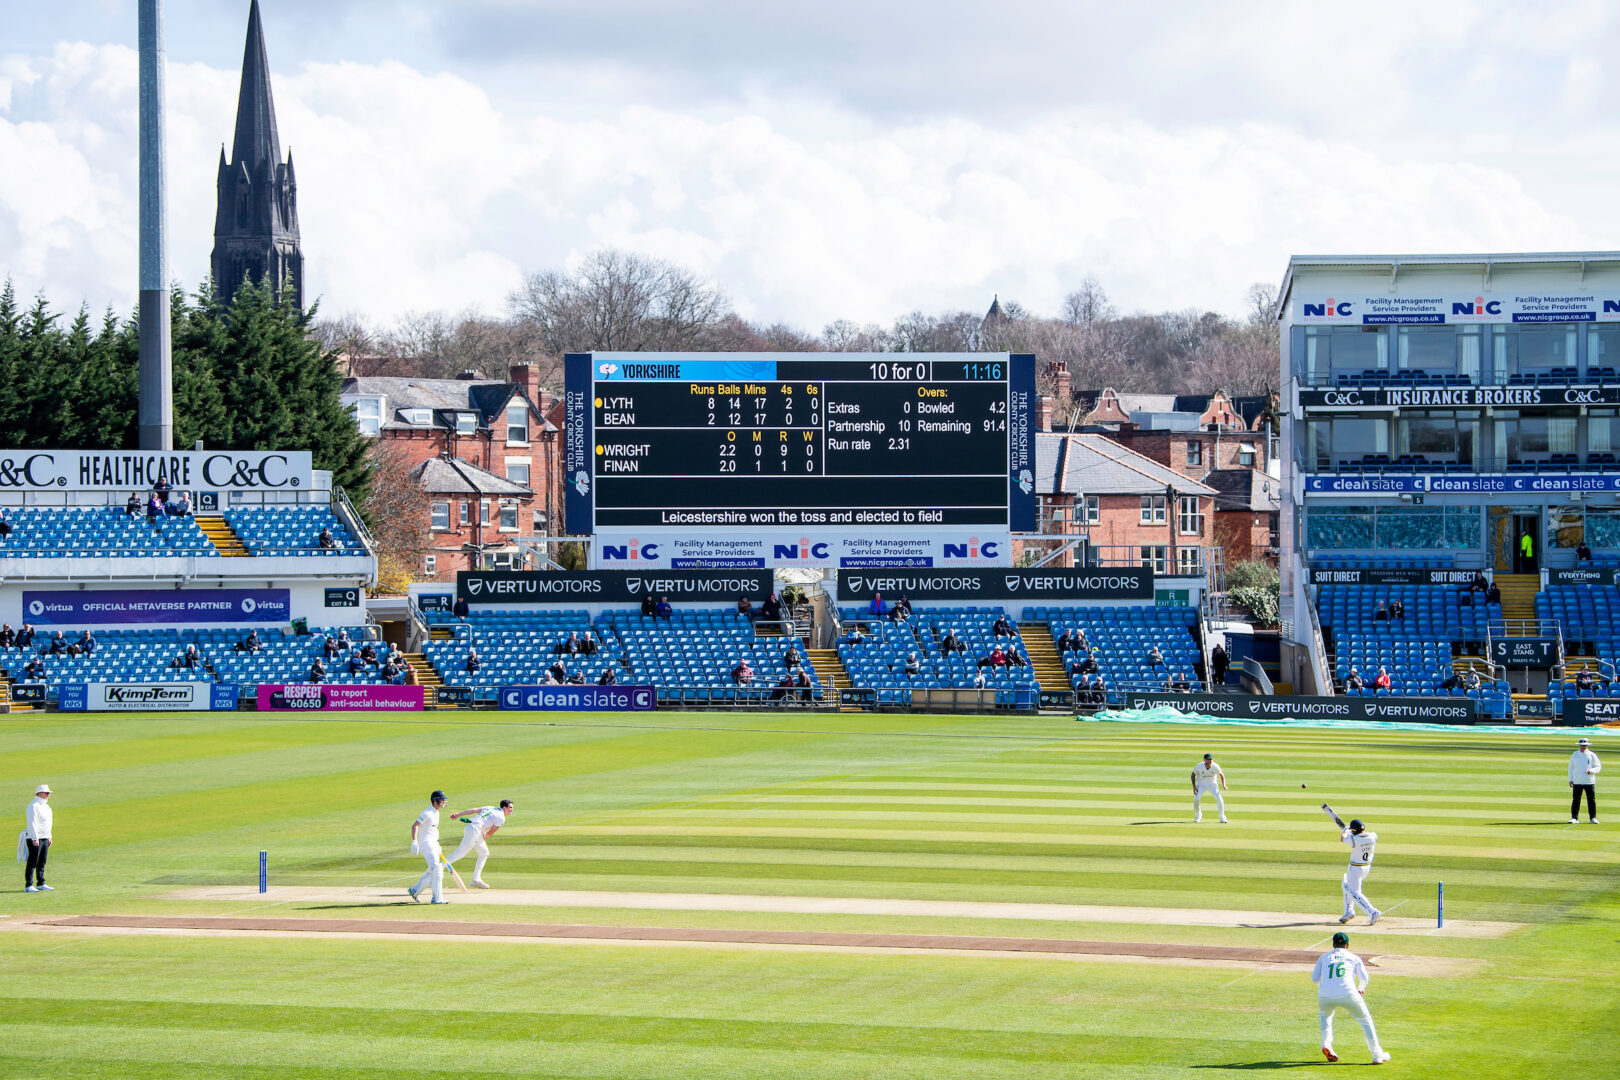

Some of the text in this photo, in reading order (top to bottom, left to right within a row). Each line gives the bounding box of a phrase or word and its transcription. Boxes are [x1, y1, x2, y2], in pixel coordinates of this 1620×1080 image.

[1394, 297, 1443, 305] Management
[1515, 296, 1594, 304] Facility Management
[1368, 315, 1439, 323] www.nicgroup.co.uk
[1517, 313, 1590, 322] www.nicgroup.co.uk
[622, 364, 680, 379] YORKSHIRE
[869, 363, 926, 380] 10 for 0
[962, 363, 1001, 380] 11:16
[690, 384, 818, 395] Runs Balls Mins 4s 6s
[917, 387, 949, 398] Overs:
[604, 397, 818, 409] LYTH 8 14 17 2 0
[1387, 389, 1541, 405] INSURANCE BROKERS
[828, 402, 911, 414] Extras 0
[918, 402, 1006, 414] Bowled 4.2
[604, 413, 818, 425] BEAN 2 12 17 0 0
[575, 391, 584, 467] THE YORKSHIRE
[828, 420, 911, 434] Partnership 10
[918, 420, 1006, 434] Remaining 91.4
[1019, 391, 1028, 466] THE YORKSHIRE
[753, 431, 814, 442] M R W
[604, 444, 813, 456] WRIGHT 2.2 0 9 0
[828, 438, 910, 450] Run rate 2.31
[80, 456, 190, 485] HEALTHCARE
[604, 460, 813, 472] FINAN 2.0 1 1 0
[1333, 479, 1404, 490] clean slate
[1433, 478, 1605, 490] clean slate clean slate
[202, 495, 212, 505] Q
[661, 510, 943, 523] Leicestershire won the toss and elected to field
[674, 540, 763, 549] Facility Management
[843, 539, 930, 548] Facility Management
[677, 559, 758, 568] wwwnicgroup.co.uk
[1315, 571, 1332, 582] SUIT
[1334, 571, 1361, 582] DIRECT
[1430, 571, 1448, 582] SUIT
[1449, 571, 1477, 582] DIRECT
[485, 579, 602, 593] VERTU MOTORS
[644, 579, 759, 592] VERTU MOTORS
[866, 577, 981, 590] VERTU MOTORS
[1023, 576, 1139, 590] VERTU MOTORS
[346, 591, 356, 601] Q
[441, 596, 448, 606] R
[45, 601, 284, 612] virtua OFFICIAL METAVERSE PARTNER virtua
[1497, 642, 1507, 655] S
[1540, 642, 1550, 655] T
[108, 688, 188, 702] KrimpTerm
[284, 686, 322, 698] RESPECT
[330, 689, 367, 698] to report
[290, 699, 321, 708] 60650
[330, 699, 416, 707] anti-social behaviour
[527, 691, 628, 707] clean slate
[1187, 701, 1234, 712] MOTORS
[1262, 703, 1349, 714] VERTU MOTORS
[1378, 706, 1467, 717] VERTU MOTORS
[1585, 703, 1619, 714] SEAT
[1328, 961, 1346, 979] 16
